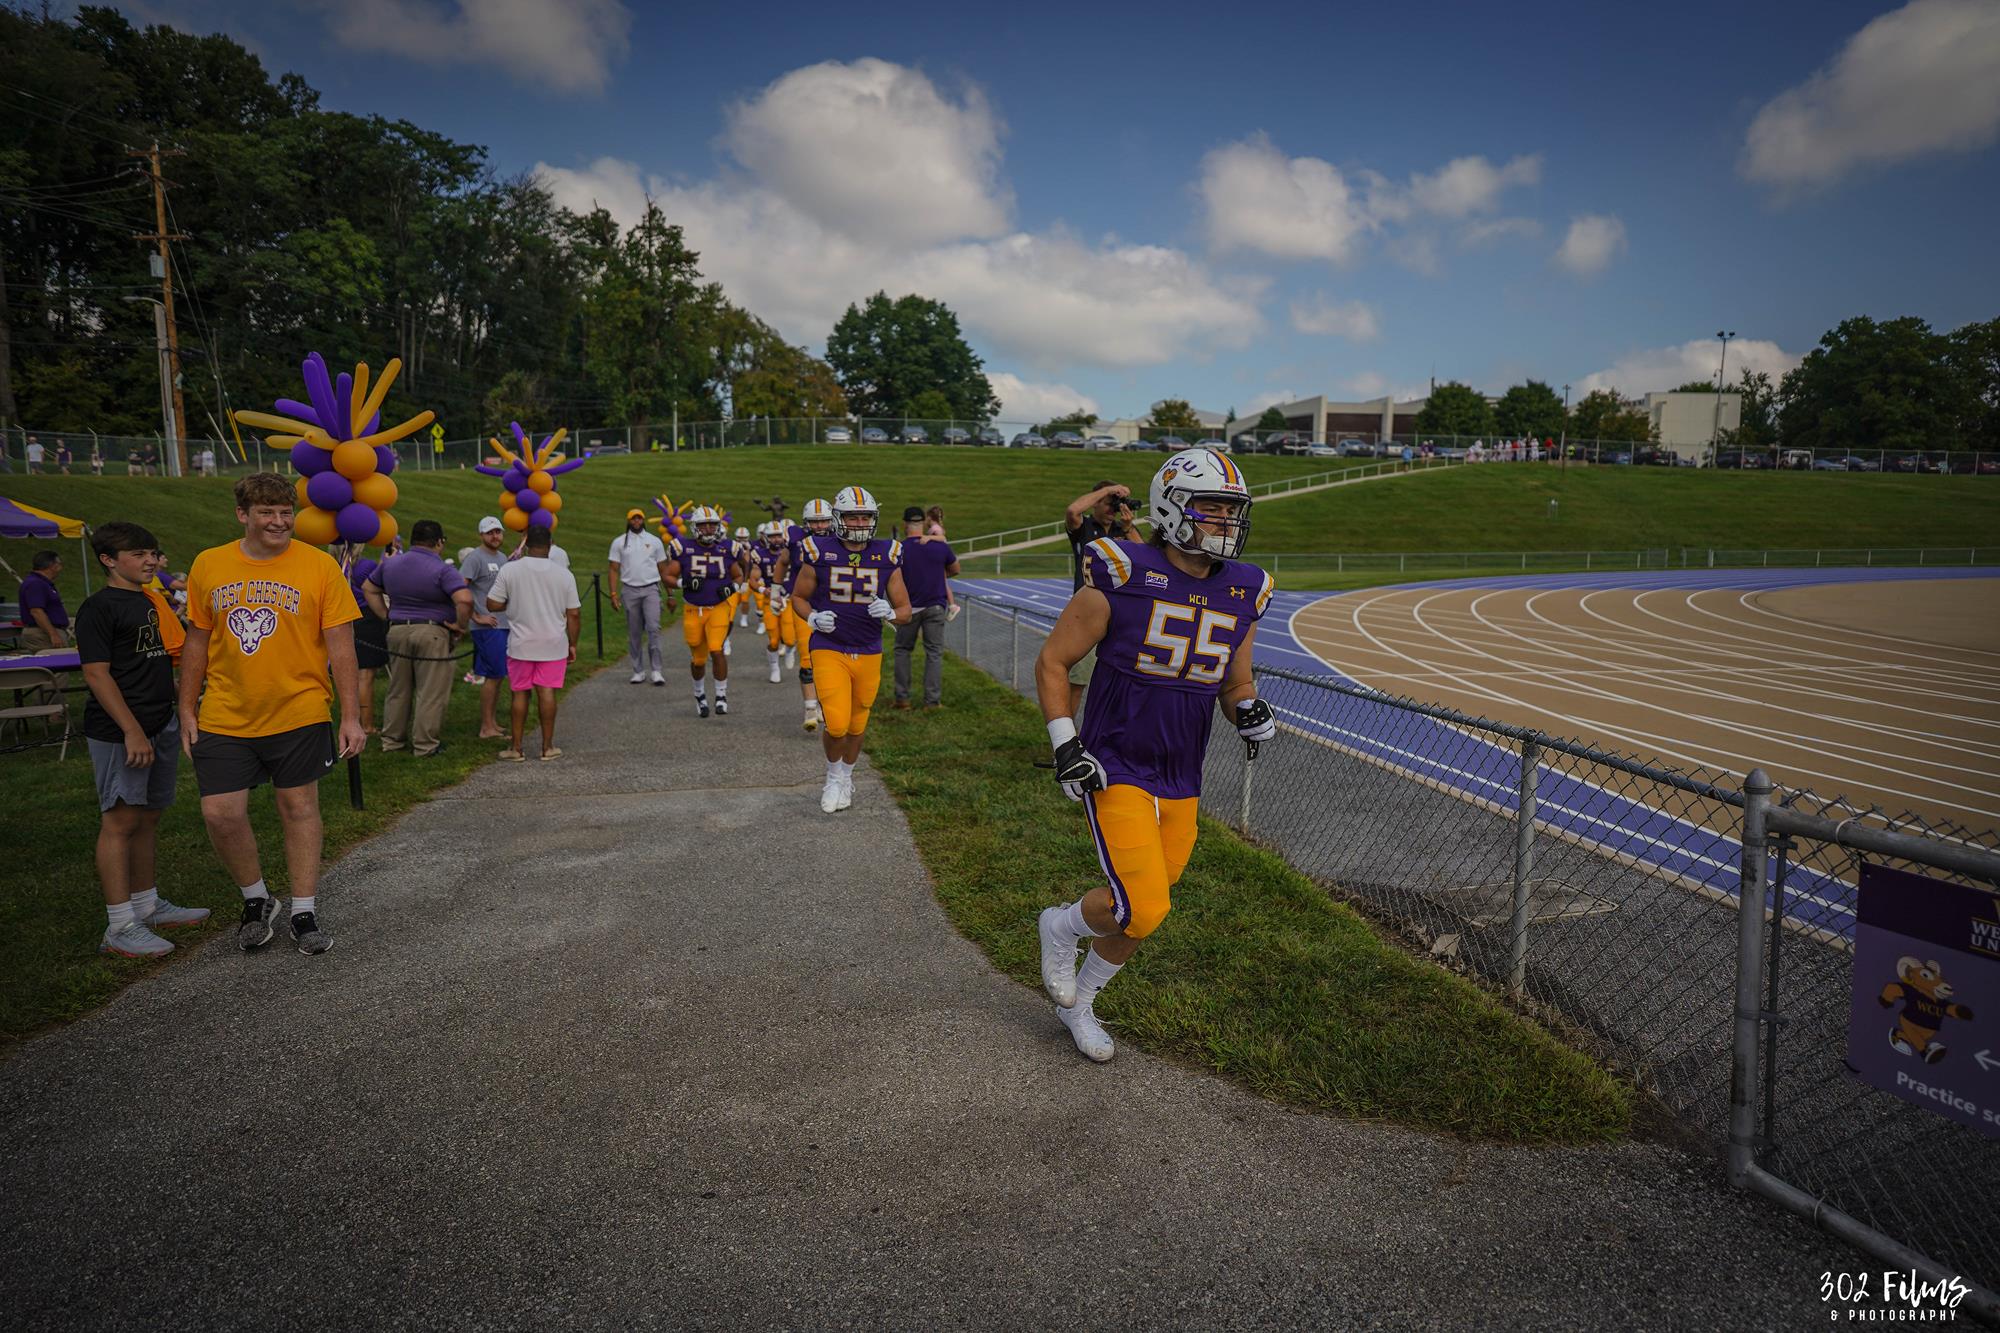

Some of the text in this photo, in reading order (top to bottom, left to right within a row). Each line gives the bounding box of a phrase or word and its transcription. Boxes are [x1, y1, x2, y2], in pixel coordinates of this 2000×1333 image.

[690, 555, 725, 579] 57
[212, 580, 300, 614] WEST CHESTER
[829, 566, 878, 603] 53
[1189, 594, 1207, 605] WCU
[1135, 600, 1237, 683] 55
[1917, 1000, 1944, 1017] WCU
[1897, 1071, 1976, 1115] Practice
